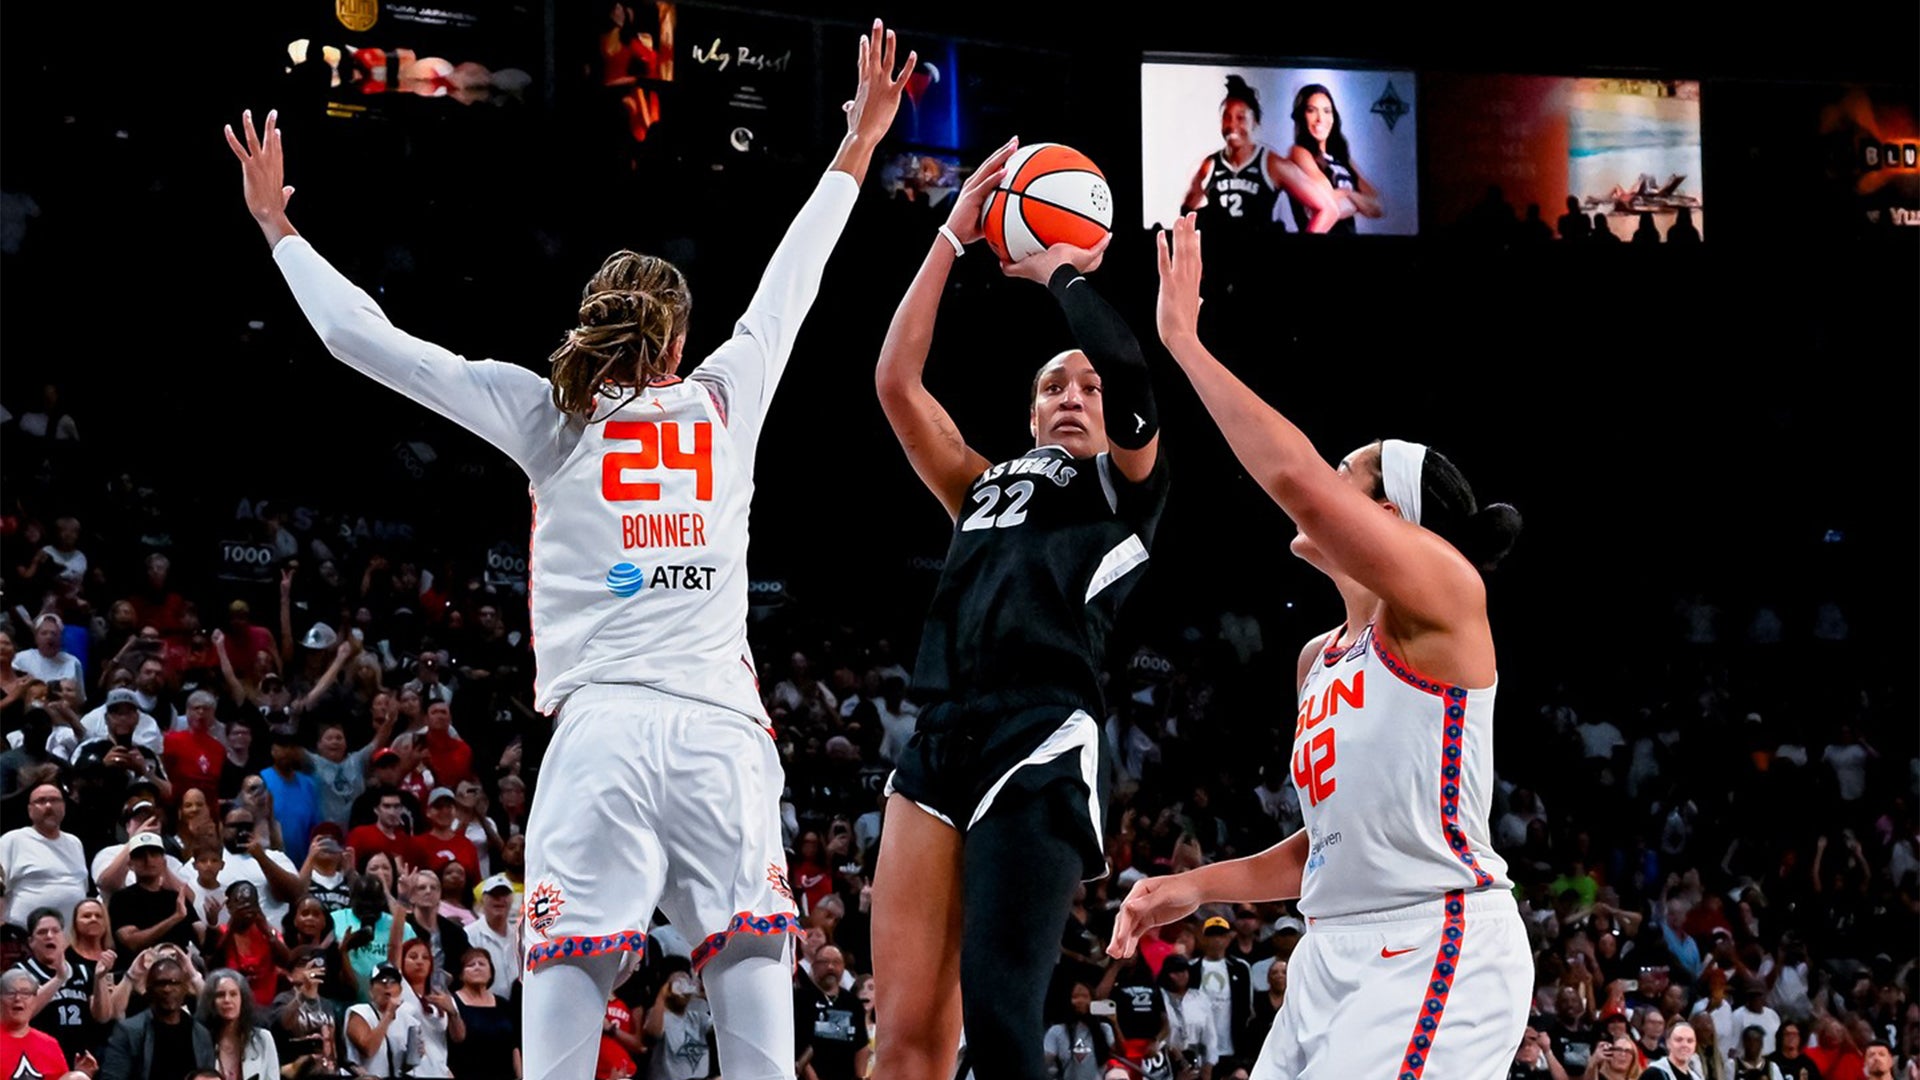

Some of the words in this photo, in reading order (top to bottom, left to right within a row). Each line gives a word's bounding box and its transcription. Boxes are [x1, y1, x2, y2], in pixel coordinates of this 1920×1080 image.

[692, 37, 732, 72] Why
[736, 46, 792, 72] Resist
[601, 420, 713, 502] 24
[1008, 456, 1079, 488] VEGAS
[234, 496, 314, 532] ACS
[960, 479, 1035, 532] 22
[621, 513, 706, 550] BONNER
[223, 544, 273, 566] 1000
[649, 565, 717, 591] AT&T
[1132, 655, 1171, 673] 1000
[1292, 727, 1336, 808] 42
[534, 896, 550, 918] C
[57, 1003, 83, 1026] 12
